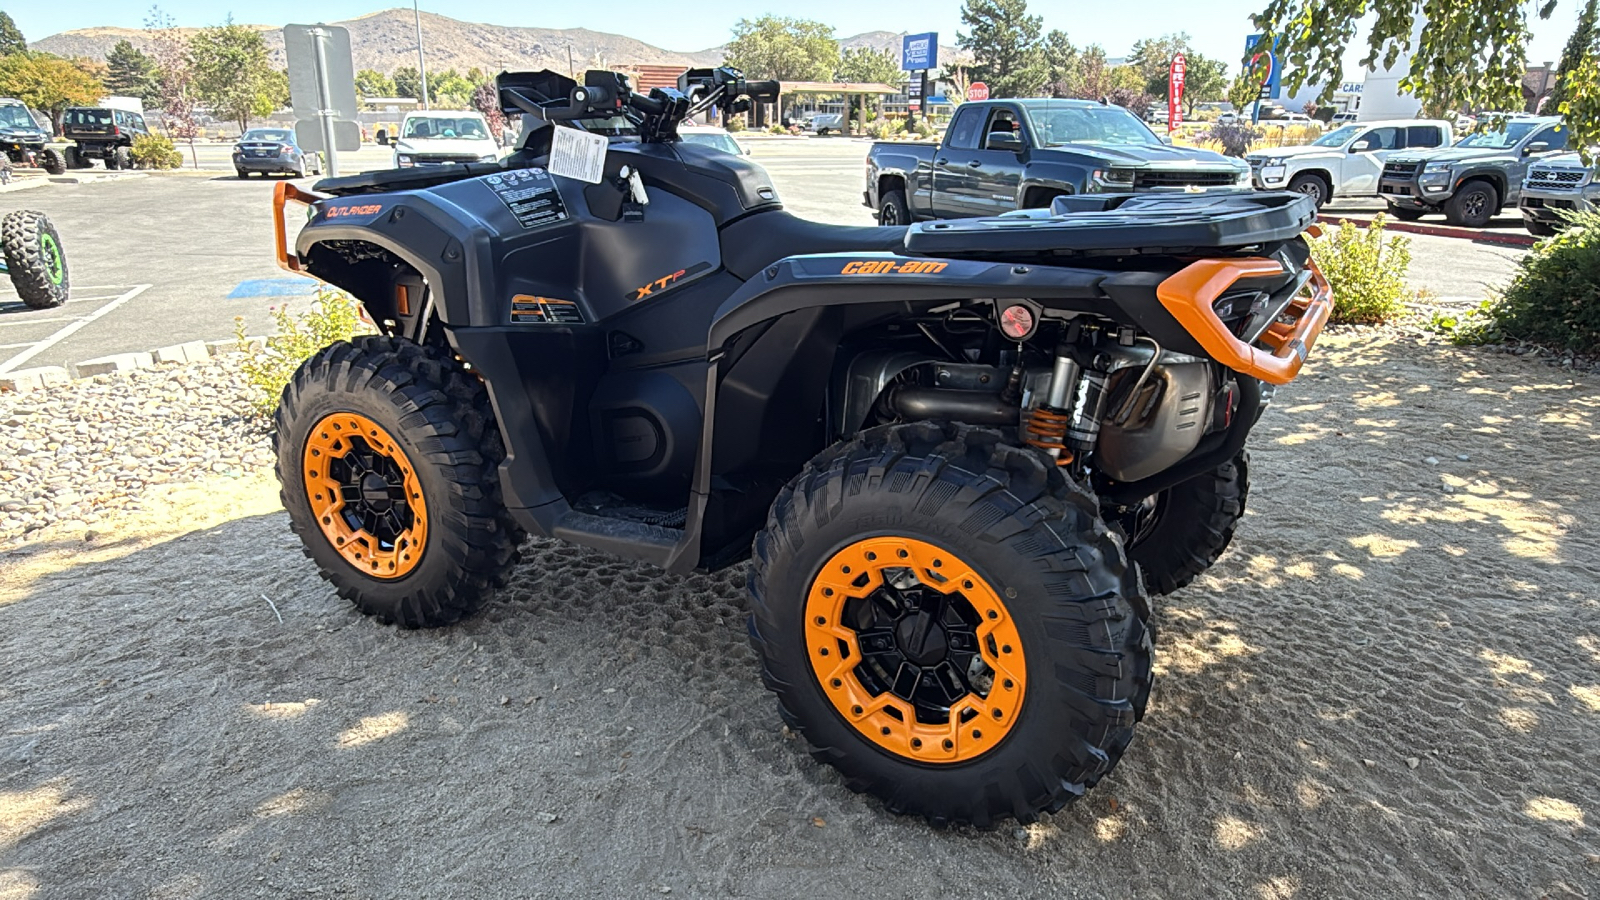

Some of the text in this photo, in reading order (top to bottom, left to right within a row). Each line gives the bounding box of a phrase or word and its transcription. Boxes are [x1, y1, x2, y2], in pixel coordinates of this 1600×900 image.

[969, 88, 988, 98] STOP
[327, 204, 382, 218] OUTLANDER
[841, 261, 949, 275] can-am
